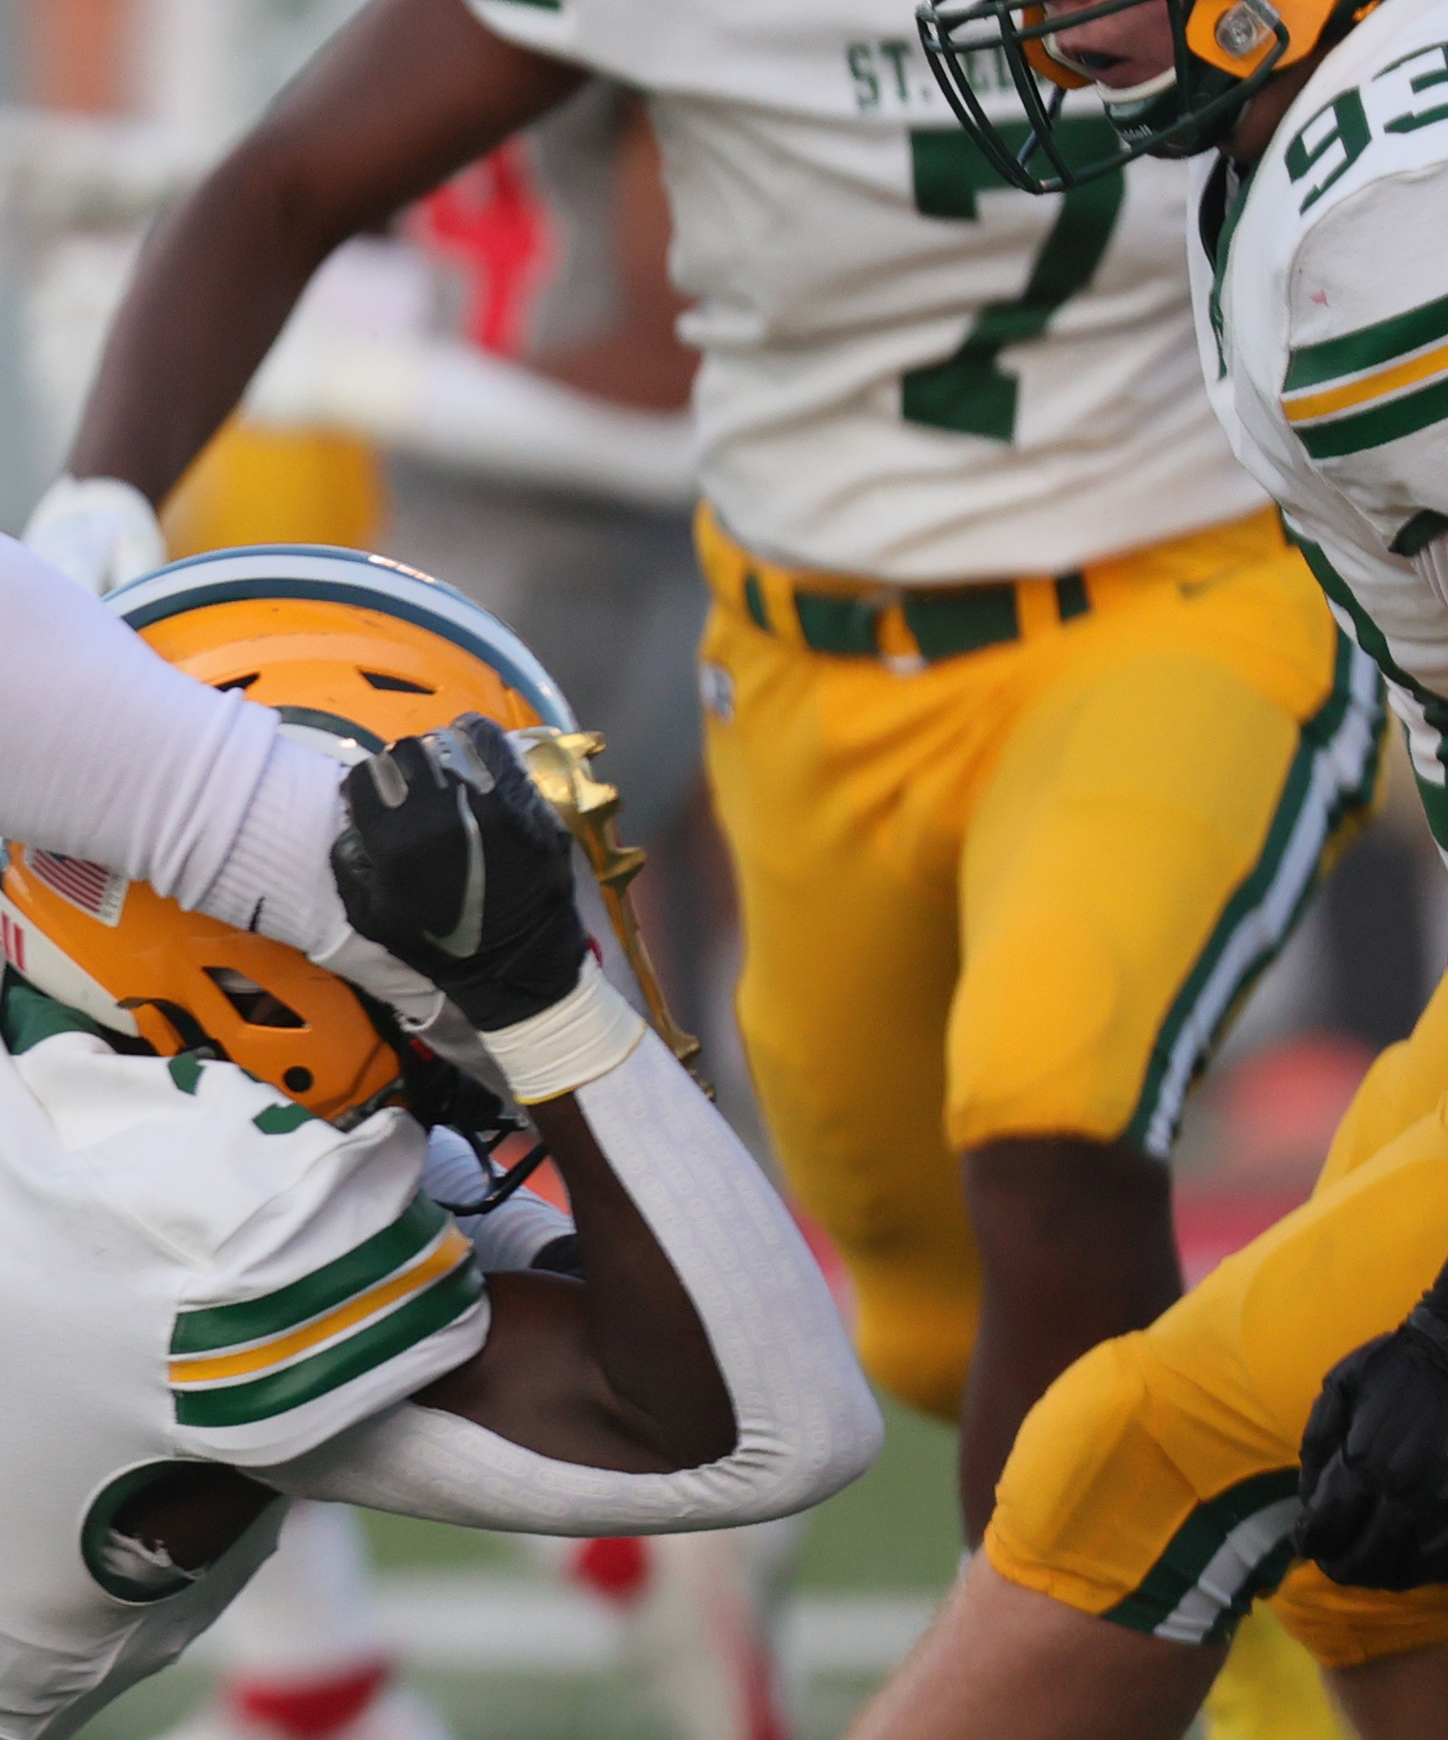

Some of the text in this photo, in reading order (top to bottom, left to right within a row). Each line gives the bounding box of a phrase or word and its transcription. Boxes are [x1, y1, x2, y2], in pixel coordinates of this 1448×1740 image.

[845, 39, 932, 109] ST.
[1284, 40, 1448, 217] 93
[901, 116, 1124, 443] 7
